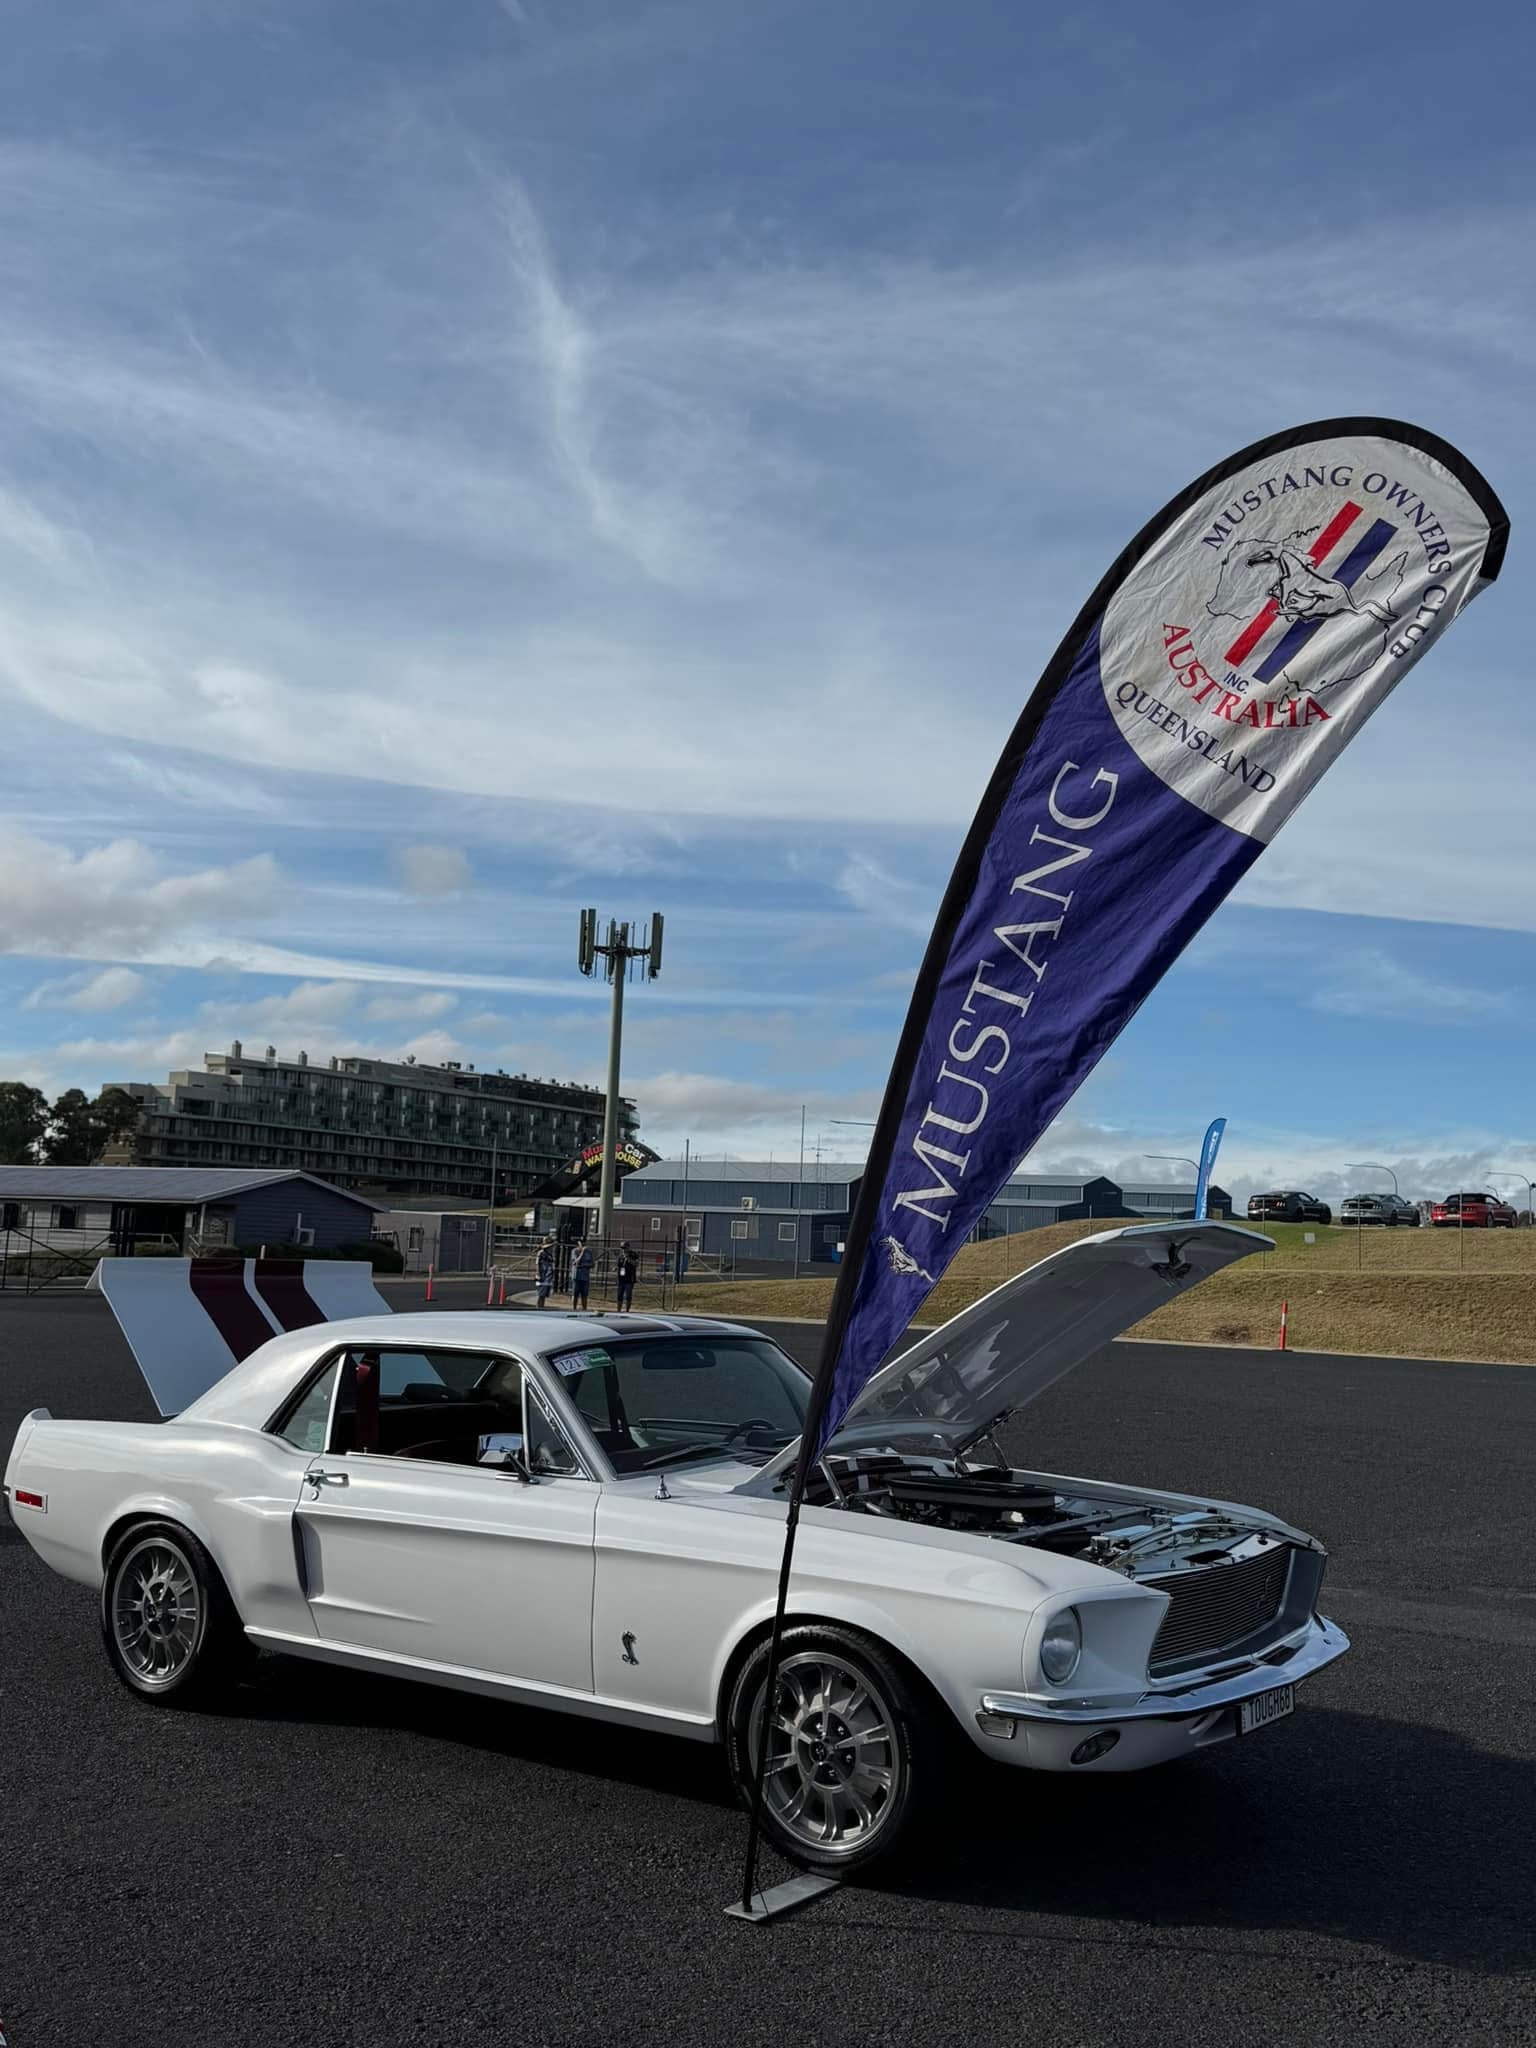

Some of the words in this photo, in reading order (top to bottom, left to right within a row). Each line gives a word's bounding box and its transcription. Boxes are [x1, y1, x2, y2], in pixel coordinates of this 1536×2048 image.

[1202, 465, 1354, 551] MUSTANG
[1362, 471, 1453, 576] OWNERS
[1389, 584, 1448, 659] CLUB
[1162, 621, 1332, 729] AUSTRALIA
[1223, 671, 1249, 694] INC.
[1115, 681, 1277, 795] QUEENSLAND
[892, 760, 1120, 1233] MUSTANG
[584, 1151, 642, 1169] WAROUSE
[625, 1143, 645, 1160] Car
